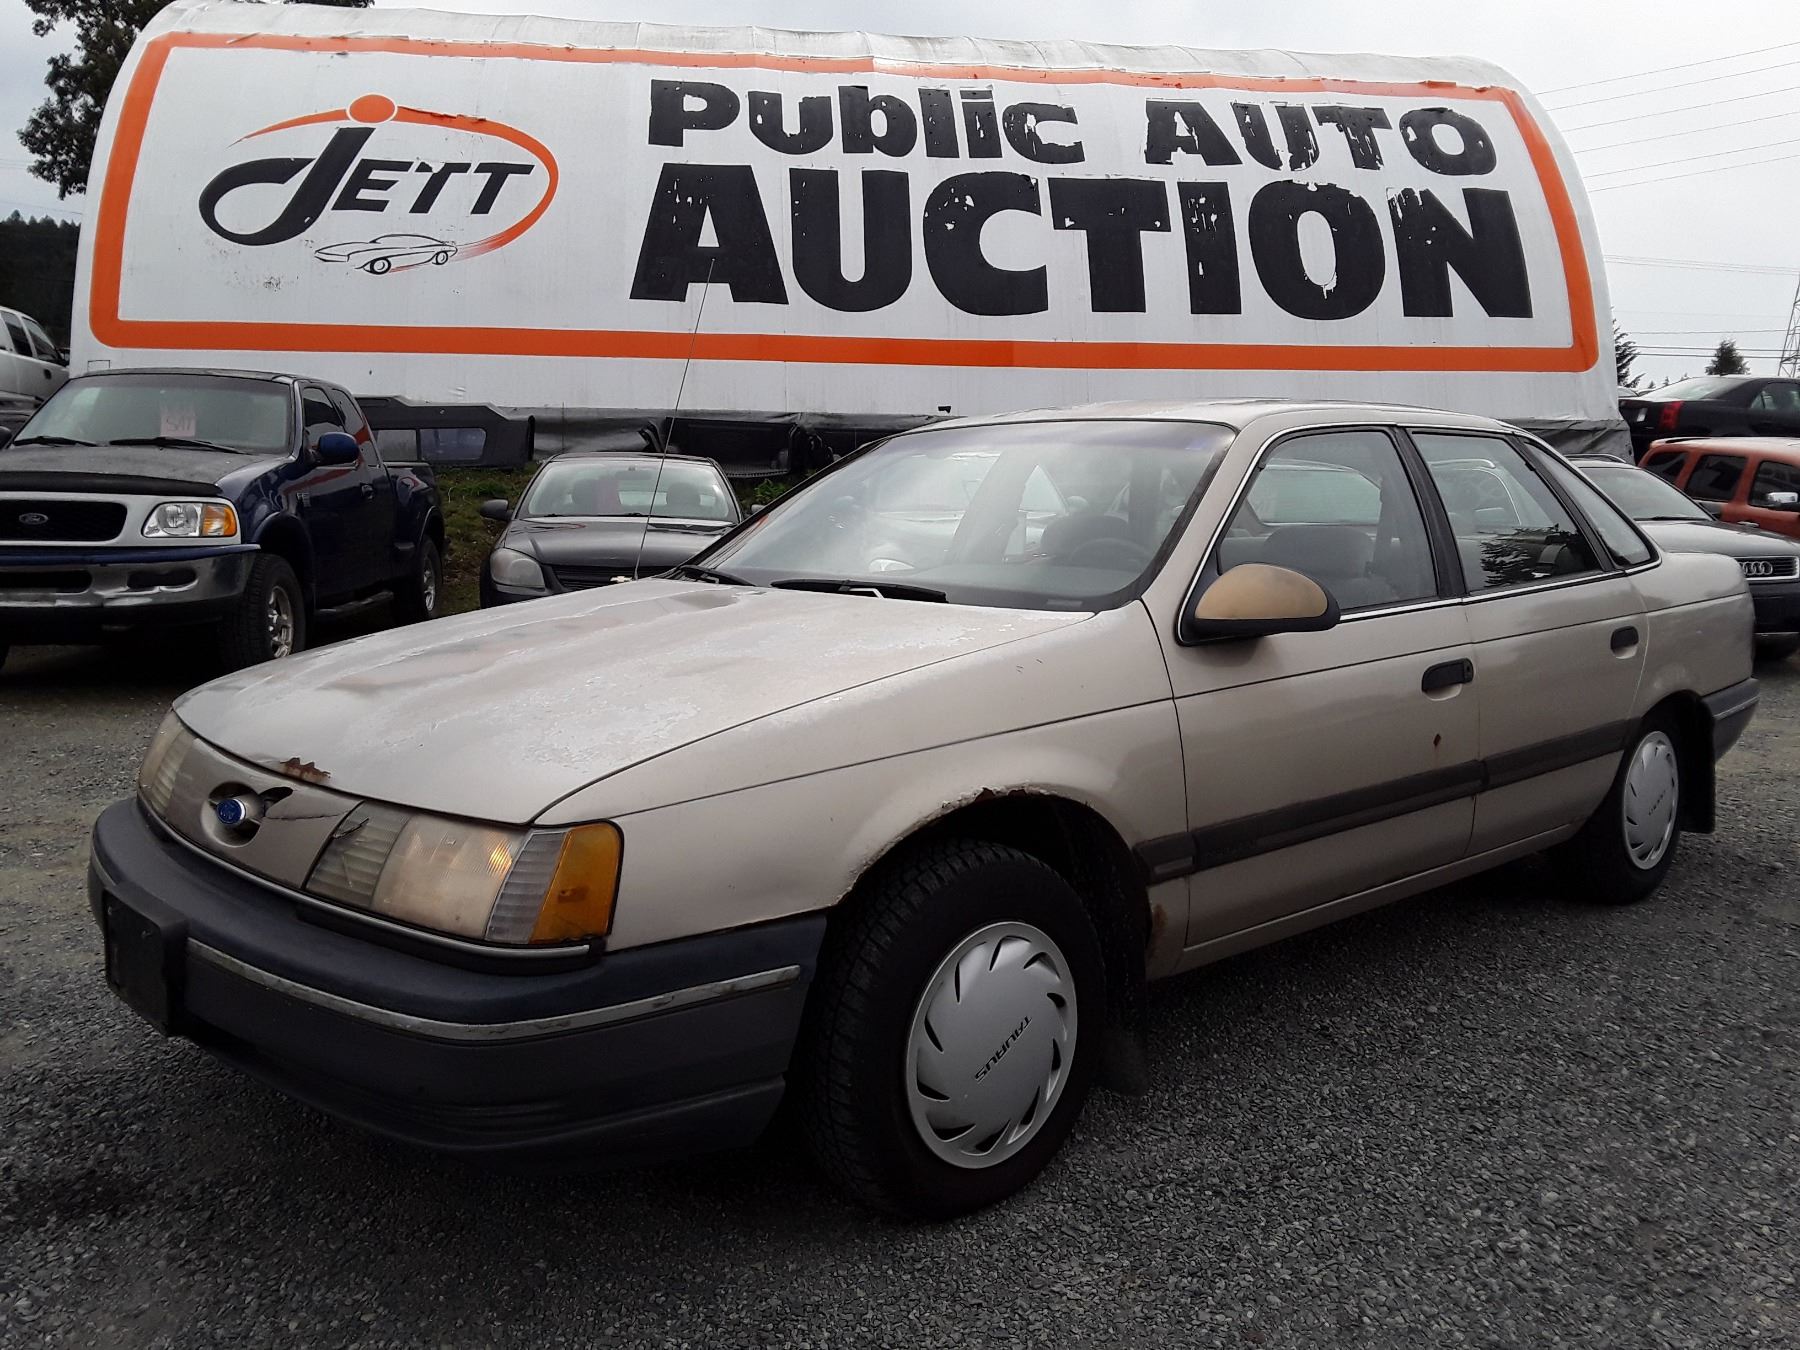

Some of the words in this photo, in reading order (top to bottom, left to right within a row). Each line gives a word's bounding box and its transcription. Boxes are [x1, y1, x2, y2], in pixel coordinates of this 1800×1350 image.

[1144, 99, 1497, 175] AUTO
[630, 163, 1532, 320] AUCTION
[975, 1015, 1033, 1083] TAURUS
